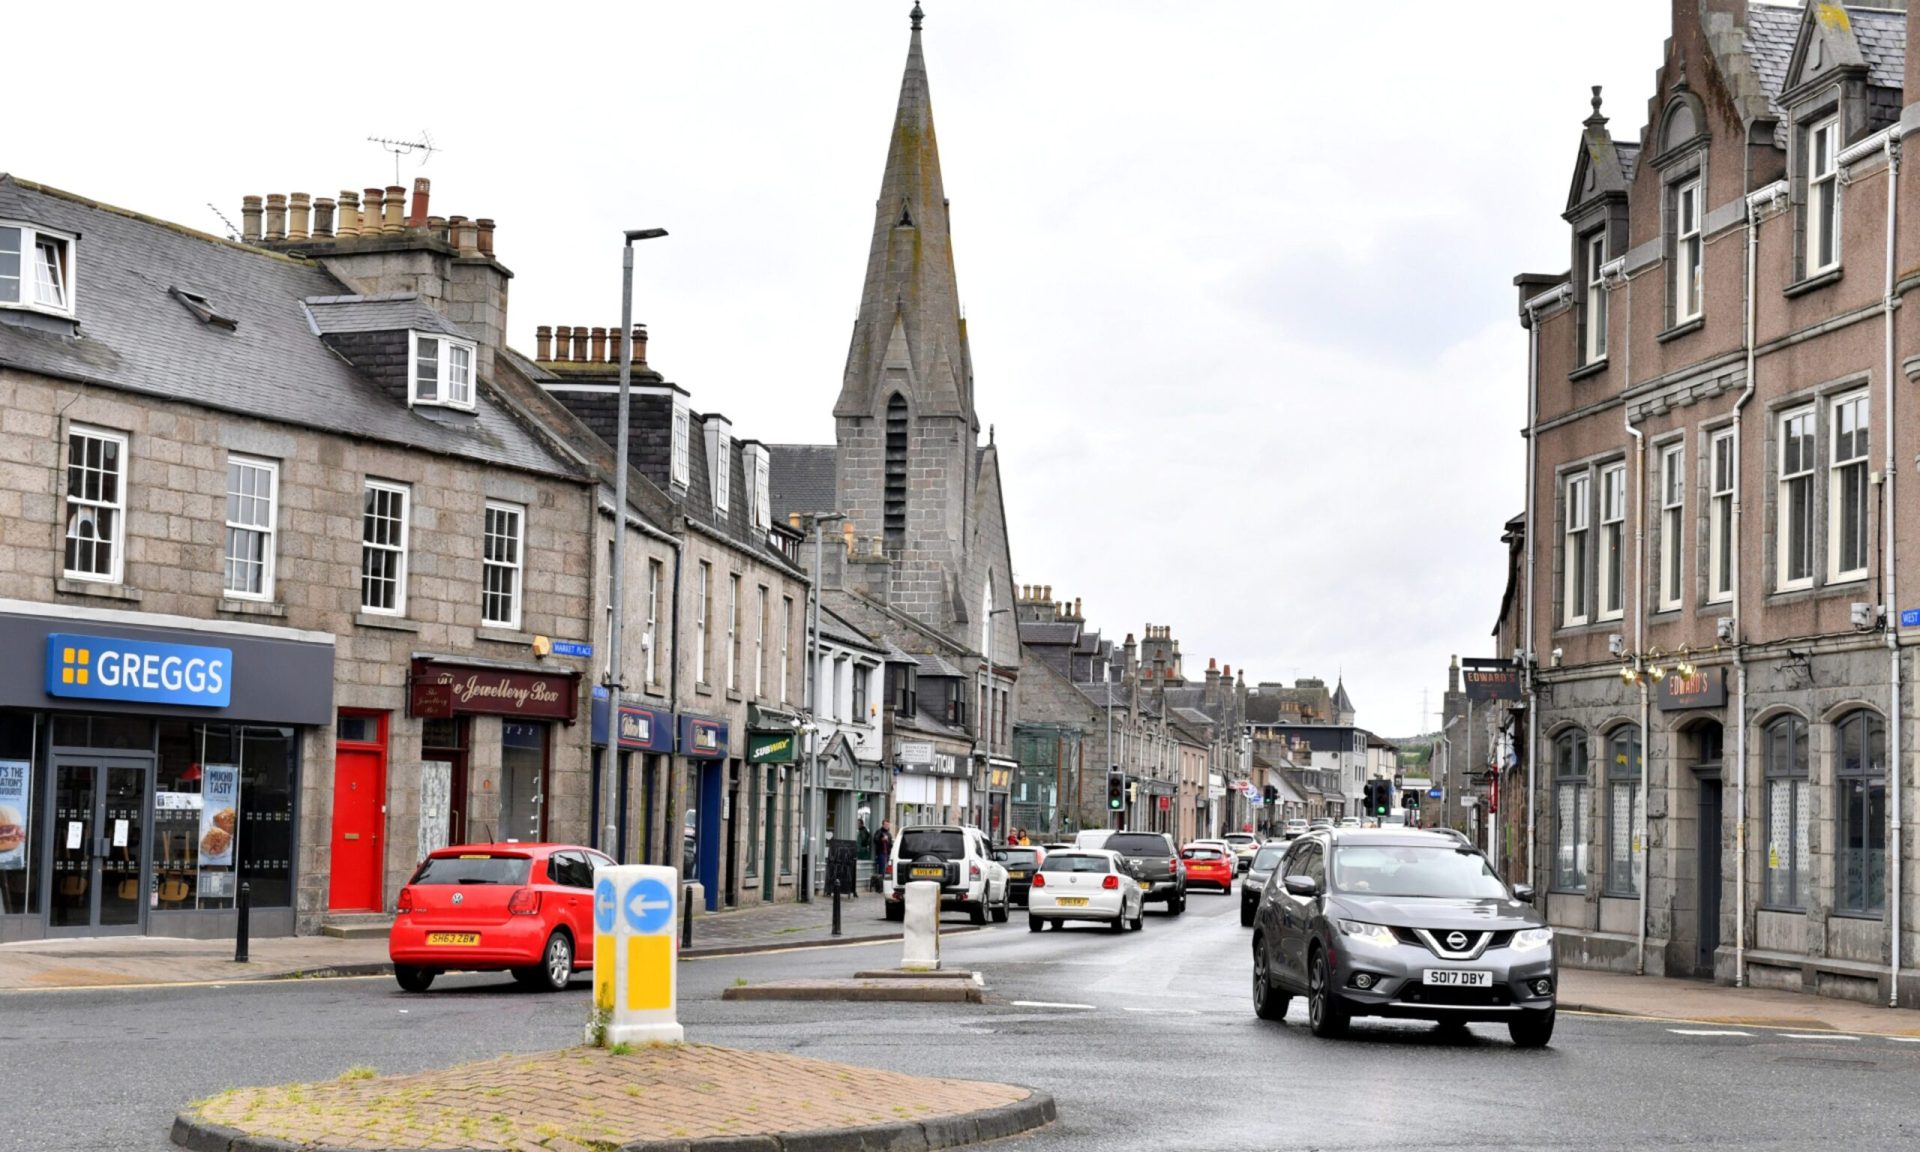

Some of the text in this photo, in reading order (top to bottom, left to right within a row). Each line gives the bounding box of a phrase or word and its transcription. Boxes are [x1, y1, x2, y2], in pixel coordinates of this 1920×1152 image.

[554, 644, 592, 655] MARKET PLACE
[97, 650, 223, 694] GREGGS
[437, 672, 560, 707] Te Jewellery Box
[753, 738, 790, 758] SUBWAY
[11, 767, 24, 778] THE
[209, 770, 233, 782] MUCHO
[210, 782, 232, 794] TASTY
[432, 933, 476, 943] SH63 ZBW
[1431, 971, 1485, 985] SO17 DBY
